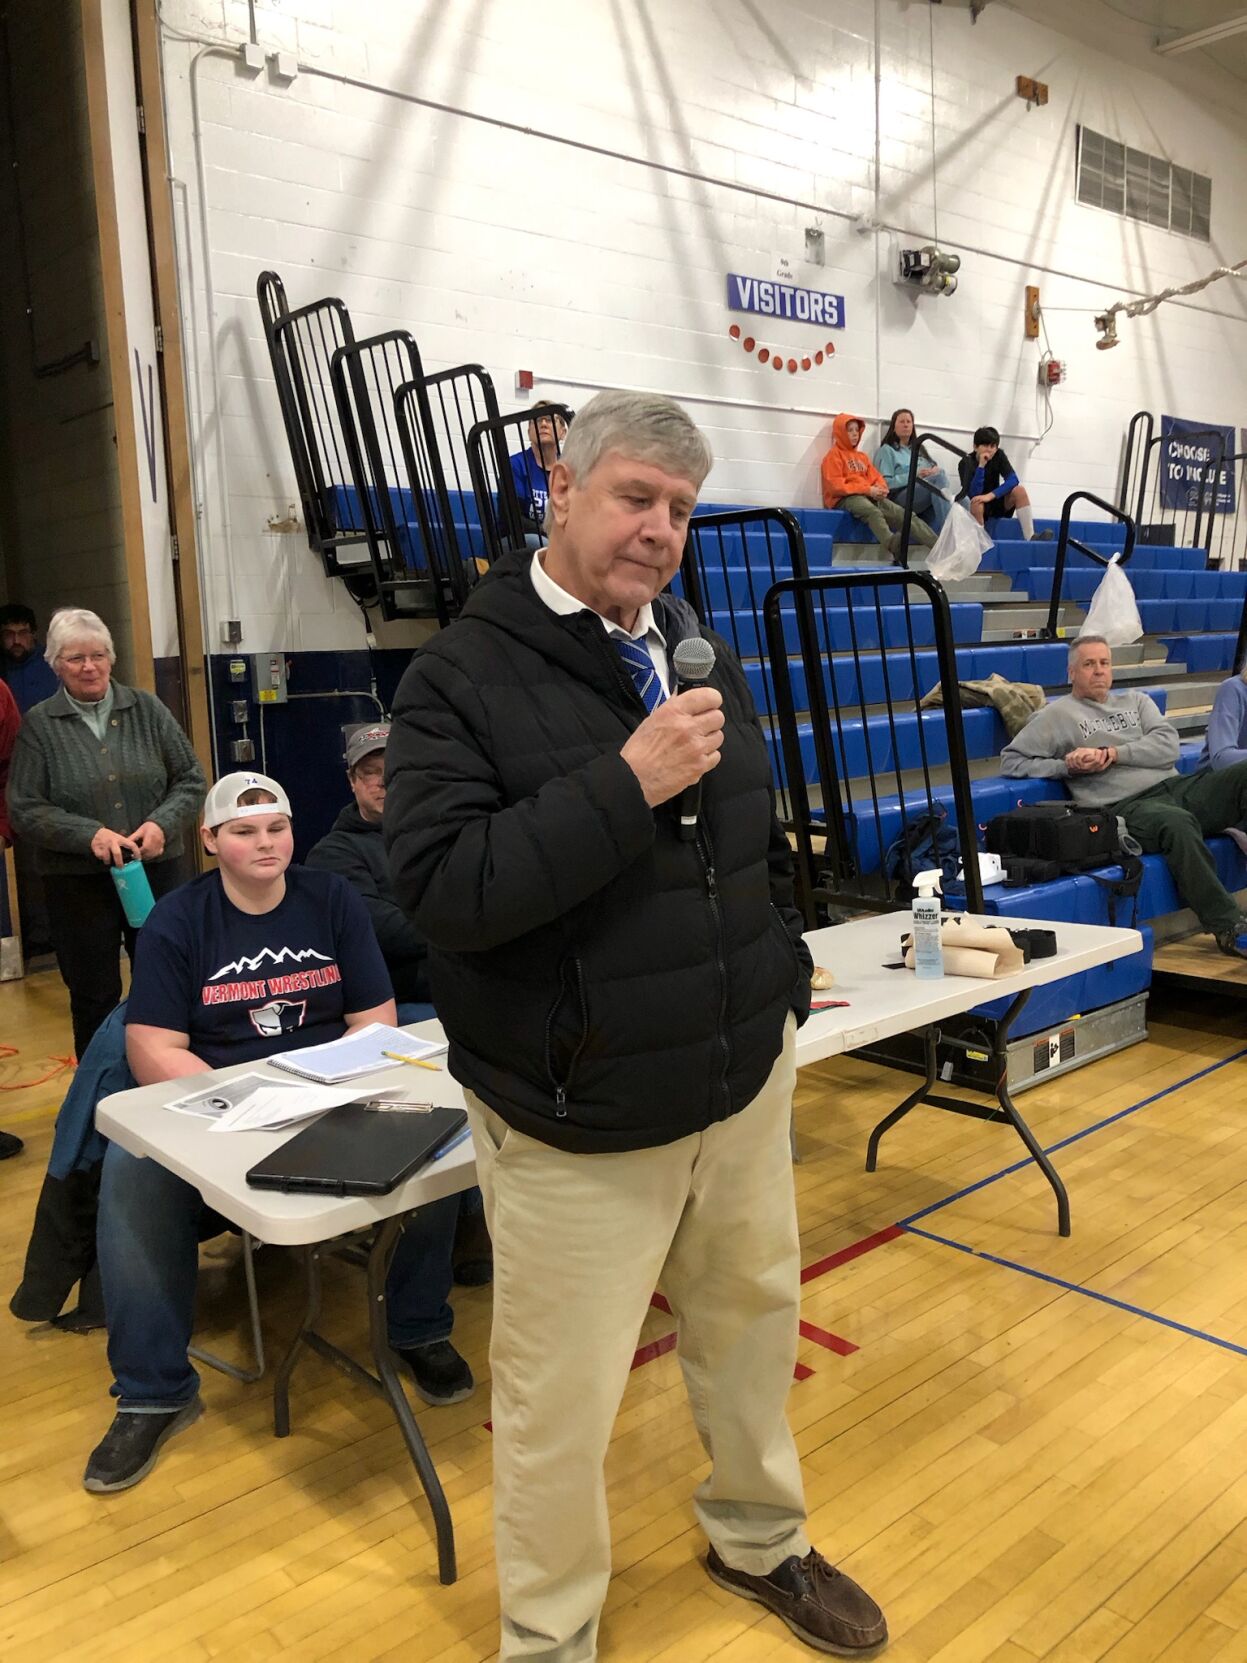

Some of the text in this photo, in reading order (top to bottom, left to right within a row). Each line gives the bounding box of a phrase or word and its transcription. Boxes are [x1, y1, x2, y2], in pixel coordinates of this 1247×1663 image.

[736, 276, 838, 325] VISITORS
[1168, 463, 1184, 480] TO
[913, 912, 939, 920] Whizzer
[202, 980, 267, 1006] VERMONT
